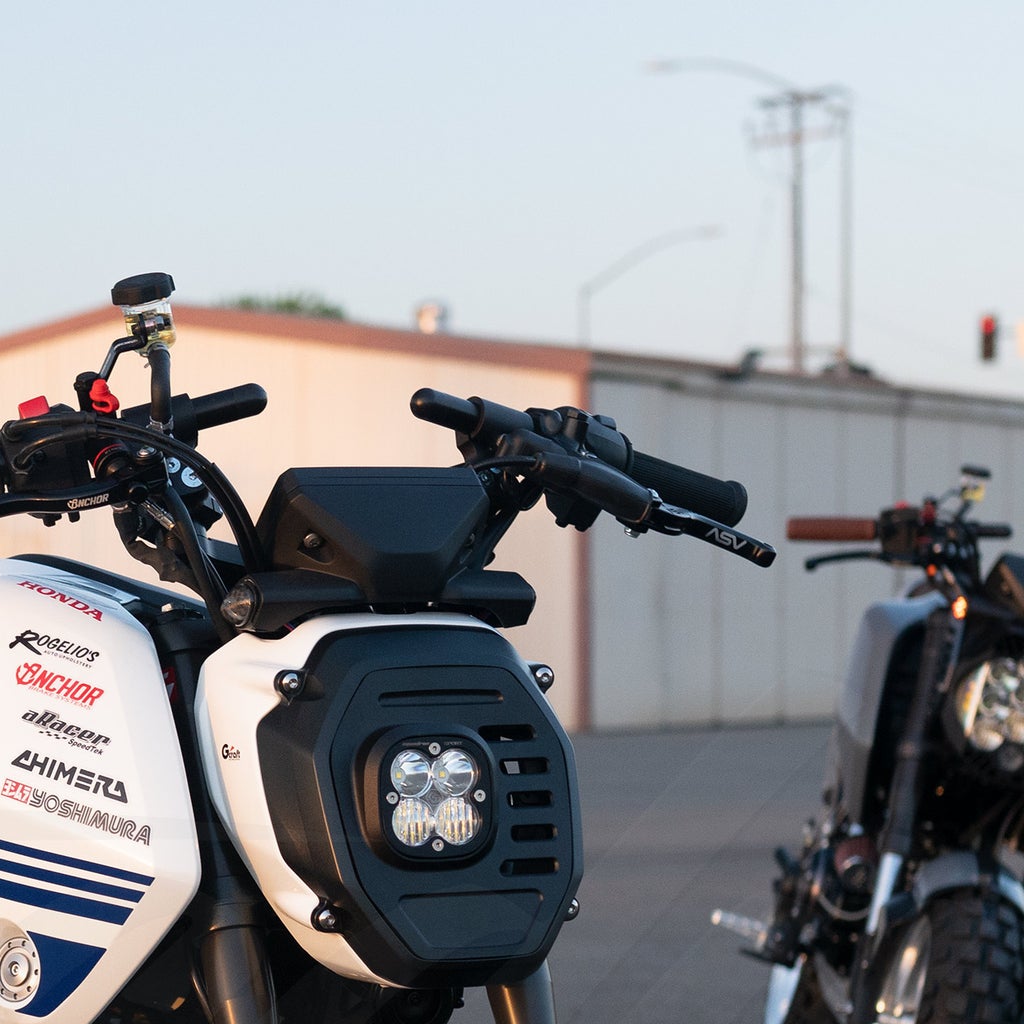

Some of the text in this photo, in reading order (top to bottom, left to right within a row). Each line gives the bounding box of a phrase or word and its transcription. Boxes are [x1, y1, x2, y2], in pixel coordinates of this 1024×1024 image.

[67, 493, 109, 510] ANCHOR
[705, 526, 747, 551] ASV
[17, 580, 104, 622] HONDA
[15, 662, 105, 706] ANCHOR
[21, 709, 112, 747] aRacer
[67, 738, 104, 756] SpeedTek
[29, 788, 152, 846] YOSHIMURA
